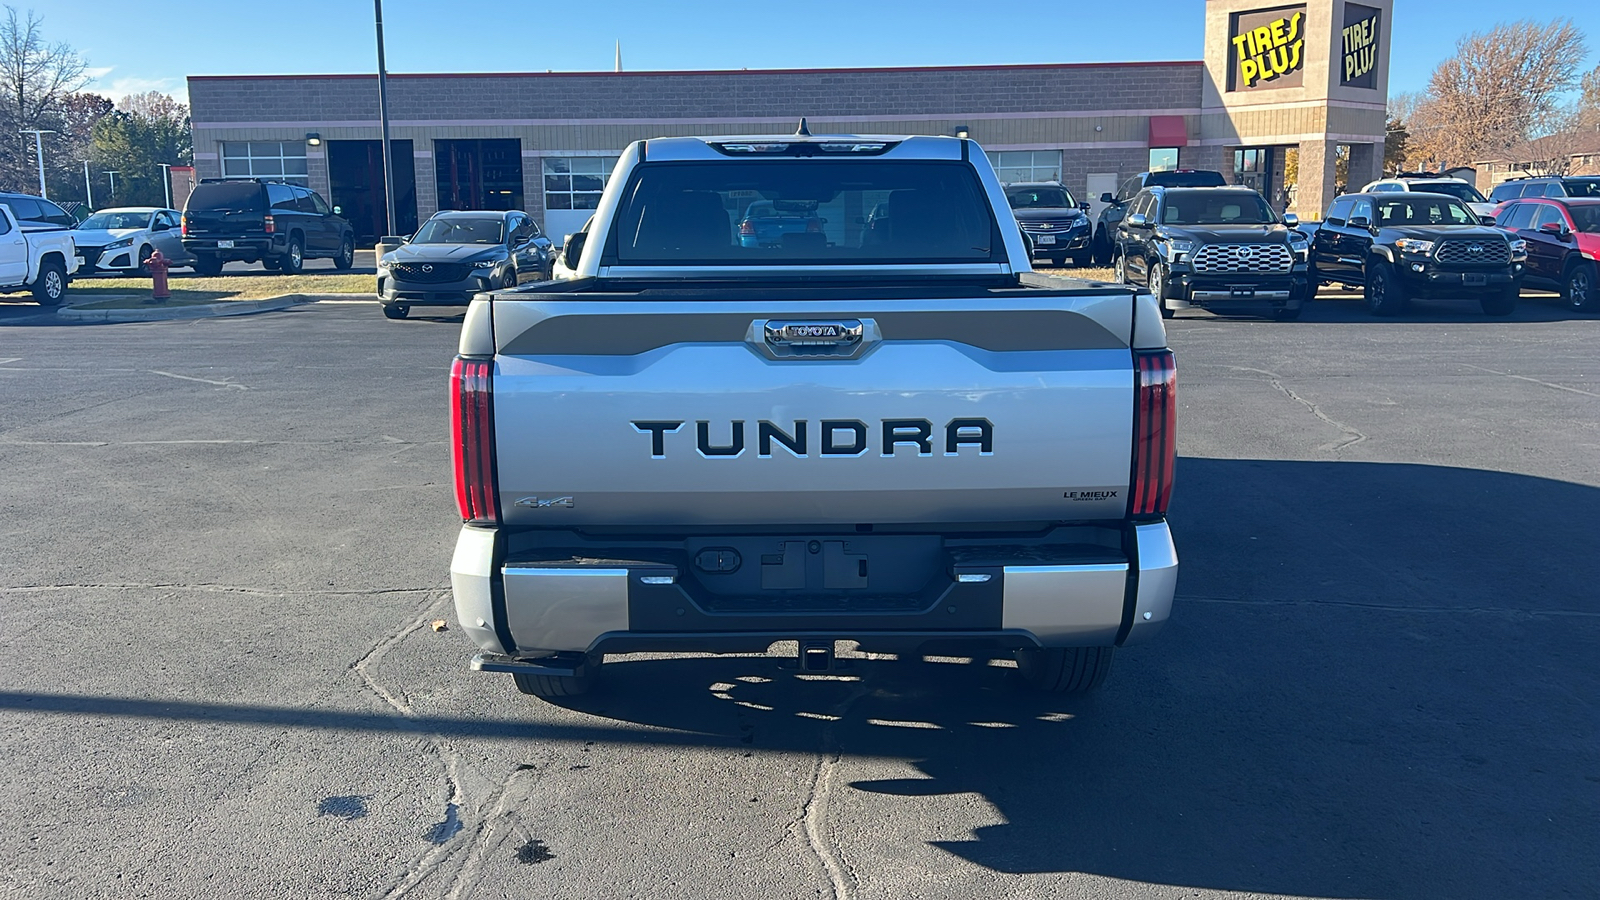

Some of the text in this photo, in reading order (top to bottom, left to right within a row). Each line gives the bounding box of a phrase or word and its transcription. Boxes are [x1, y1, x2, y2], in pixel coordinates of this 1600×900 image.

[1232, 11, 1302, 61] TIRES
[1342, 15, 1377, 54] TIRES
[1240, 38, 1303, 87] PLUS
[1344, 43, 1377, 82] PLUS
[791, 326, 837, 337] TOYOTA
[629, 416, 995, 460] TUNDRA
[1063, 490, 1118, 499] LE MIEUX
